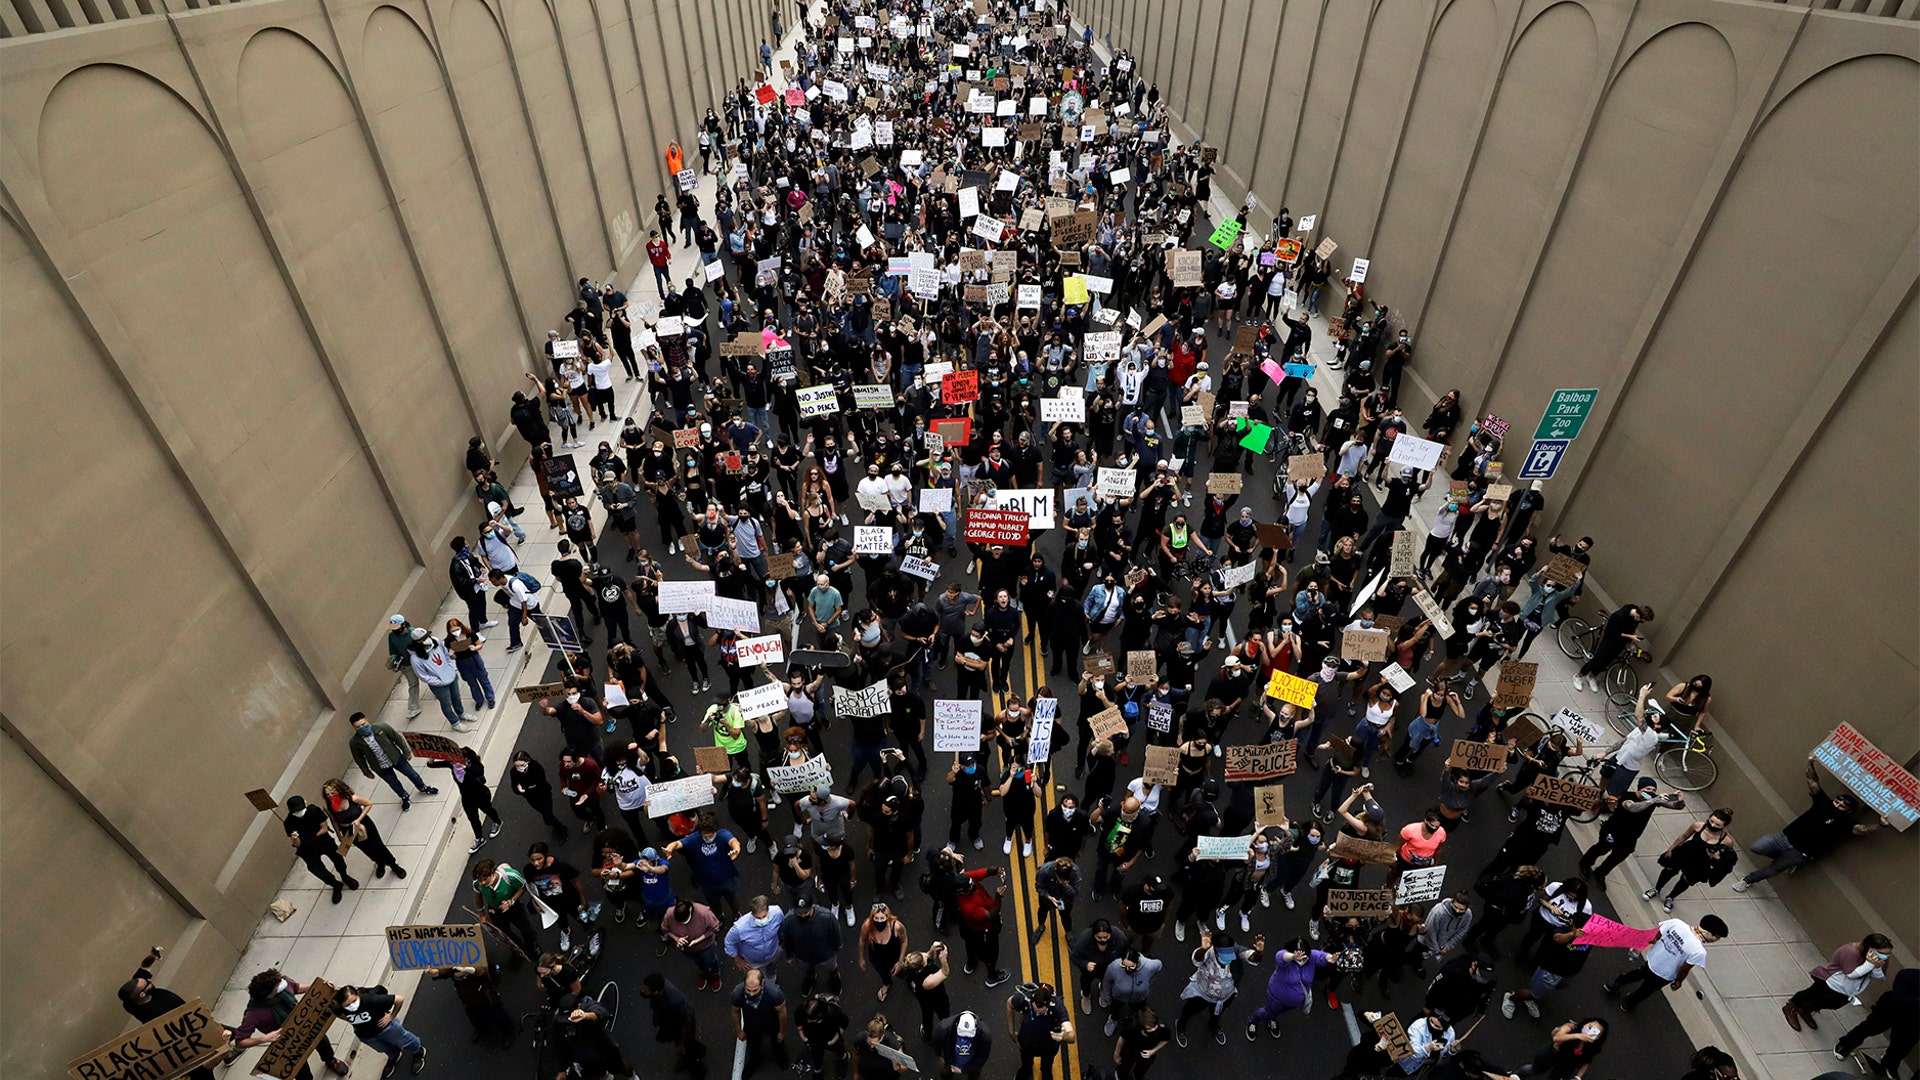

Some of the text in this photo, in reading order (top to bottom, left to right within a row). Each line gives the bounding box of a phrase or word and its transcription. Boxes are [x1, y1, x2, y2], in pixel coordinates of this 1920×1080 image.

[1054, 216, 1076, 229] WHITE
[1054, 224, 1082, 237] SILENCE
[769, 351, 792, 361] BLACK
[771, 365, 795, 374] MATTER
[952, 380, 969, 388] UNIDO
[798, 389, 835, 402] NO JUSTICE
[1557, 392, 1591, 403] Balboa
[802, 403, 836, 414] NO PEACE
[1557, 404, 1580, 414] Park
[1552, 418, 1571, 428] Zoo
[677, 439, 699, 448] COPS
[1535, 443, 1565, 452] Library
[1104, 477, 1129, 485] ANGRY
[970, 512, 1001, 520] BREONNA
[860, 528, 886, 536] BLACK
[969, 521, 1024, 531] AHMAUD AUBREY
[968, 530, 1021, 540] GEORGE FLOYD
[856, 543, 890, 552] MATTER
[1396, 544, 1412, 552] LOVE
[903, 561, 938, 575] BLACK LIVES
[1346, 631, 1356, 641] In
[738, 639, 782, 658] ENOUGH
[1271, 670, 1317, 696] BLACK LIVES
[1511, 684, 1518, 694] I
[739, 683, 781, 699] NO JUSTICE
[846, 686, 876, 703] END
[1273, 687, 1306, 705] MATTER
[757, 699, 780, 710] PEACE
[839, 691, 887, 709] POLICE
[1498, 694, 1528, 705] STAND
[836, 701, 891, 717] BRUTALITY
[1562, 708, 1583, 722] BLACK
[1149, 721, 1168, 731] LIVES
[1150, 715, 1169, 724] BLACK
[1033, 721, 1051, 740] IS
[1569, 719, 1591, 734] LIVES
[1570, 725, 1597, 744] MATTER
[937, 740, 975, 748] Creation
[1232, 743, 1289, 760] DEMILITARIZE
[1831, 733, 1859, 756] THAT
[1857, 755, 1888, 783] WORK
[1234, 755, 1289, 774] THE POLICE
[1837, 724, 1920, 794] SOME OF THOSE
[771, 758, 822, 778] NOBODY
[1815, 747, 1891, 814] BURN CROSSES
[1822, 740, 1920, 822] ARE THE SAME THAT
[1537, 776, 1598, 801] ABOLISH
[1534, 788, 1594, 810] THE POLICE
[1331, 890, 1387, 901] NO JUSTICE
[1142, 901, 1162, 912] PUBG
[1330, 901, 1390, 912] NO PEACE
[389, 927, 476, 940] HIS NAME WAS
[257, 988, 322, 1073] DEFUND COPS
[282, 998, 328, 1060] INVEST IN
[76, 1007, 208, 1080] BLACK LIVES
[1383, 1018, 1409, 1057] BLM
[108, 1033, 212, 1080] MATTER
